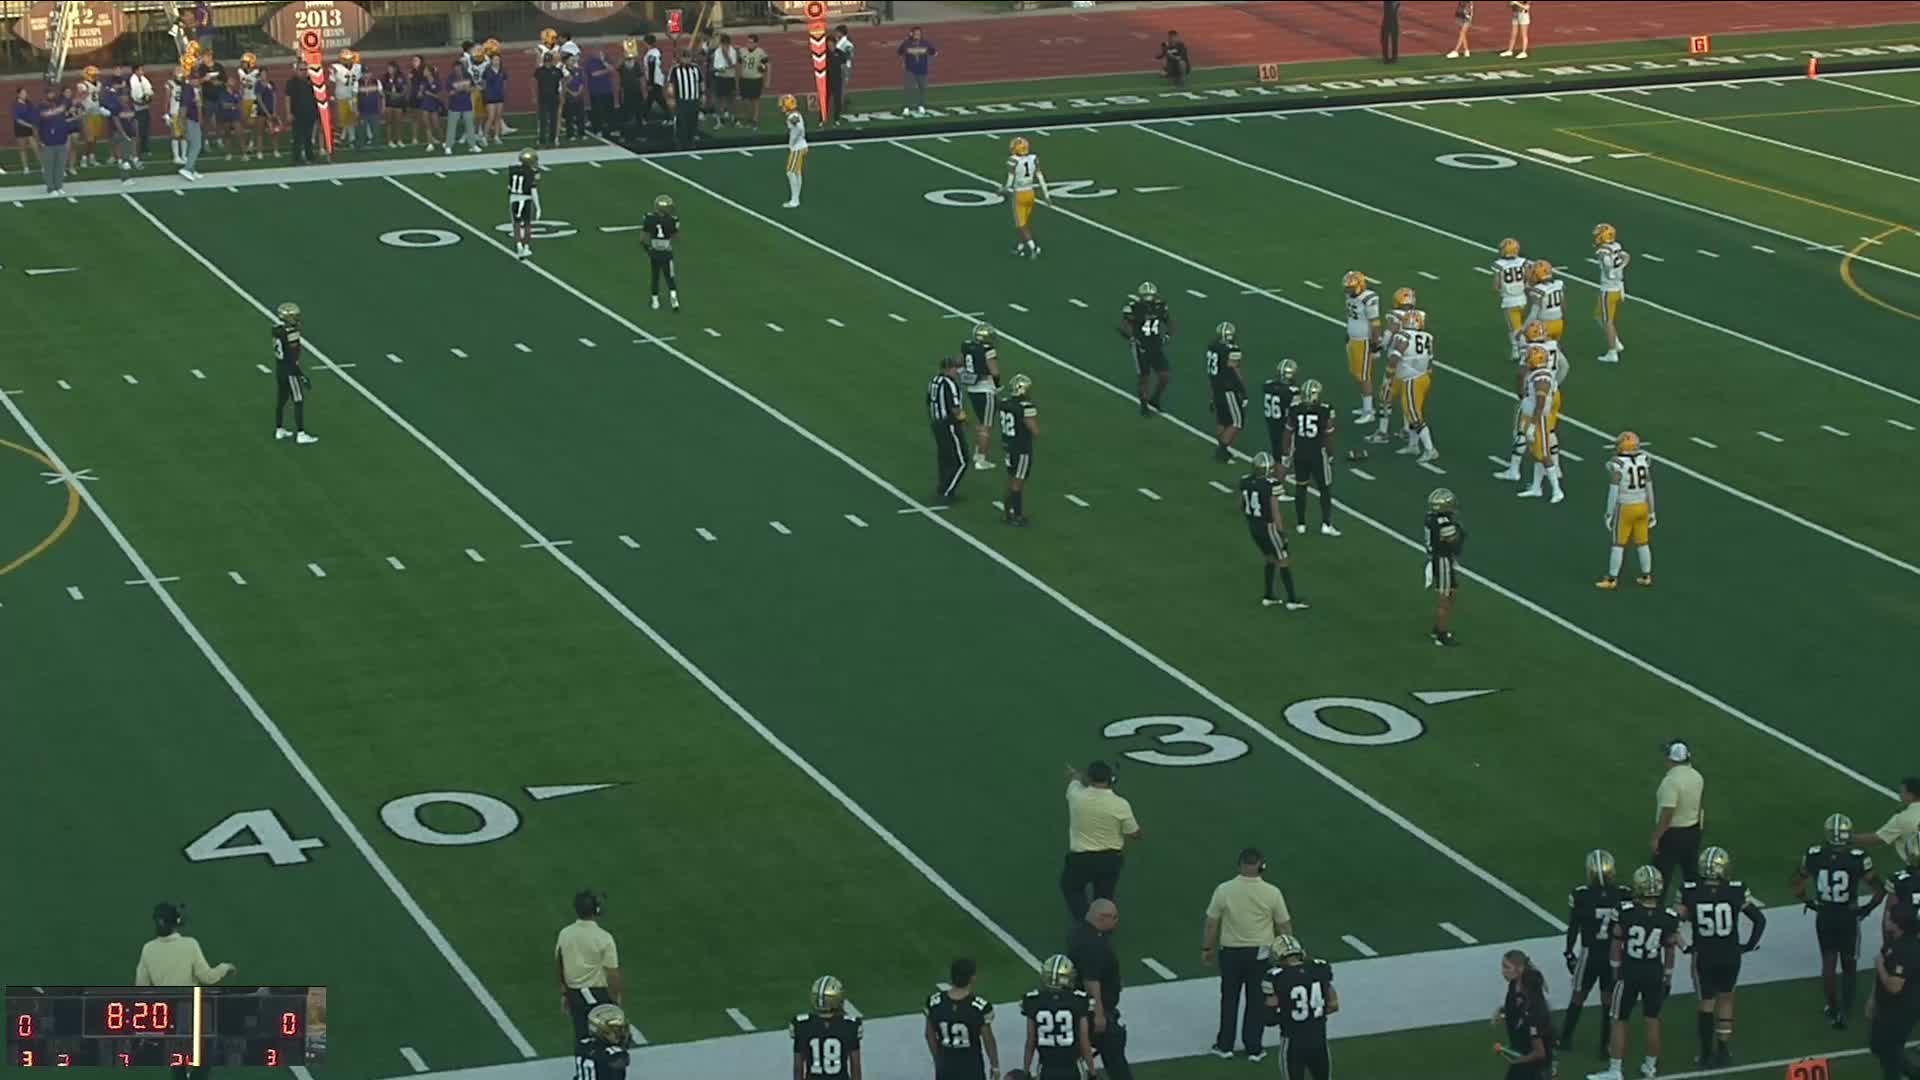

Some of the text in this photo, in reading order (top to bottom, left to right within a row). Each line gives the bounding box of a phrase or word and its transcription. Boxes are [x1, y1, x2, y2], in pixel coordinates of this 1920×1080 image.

[295, 8, 341, 28] 2013
[1159, 69, 1534, 100] MEMORIAL
[1260, 65, 1276, 80] 10
[511, 174, 525, 195] 11
[655, 224, 665, 239] 1
[1503, 267, 1524, 284] 88
[1141, 319, 1160, 337] 44
[1263, 392, 1282, 419] 56
[1297, 414, 1318, 438] 15
[1626, 466, 1648, 490] 18
[1243, 489, 1262, 517] 14
[1816, 868, 1850, 903] 42
[1695, 902, 1734, 938] 50
[1626, 924, 1663, 960] 24
[1290, 981, 1325, 1021] 34
[1035, 1010, 1074, 1047] 23
[808, 1037, 842, 1075] 18
